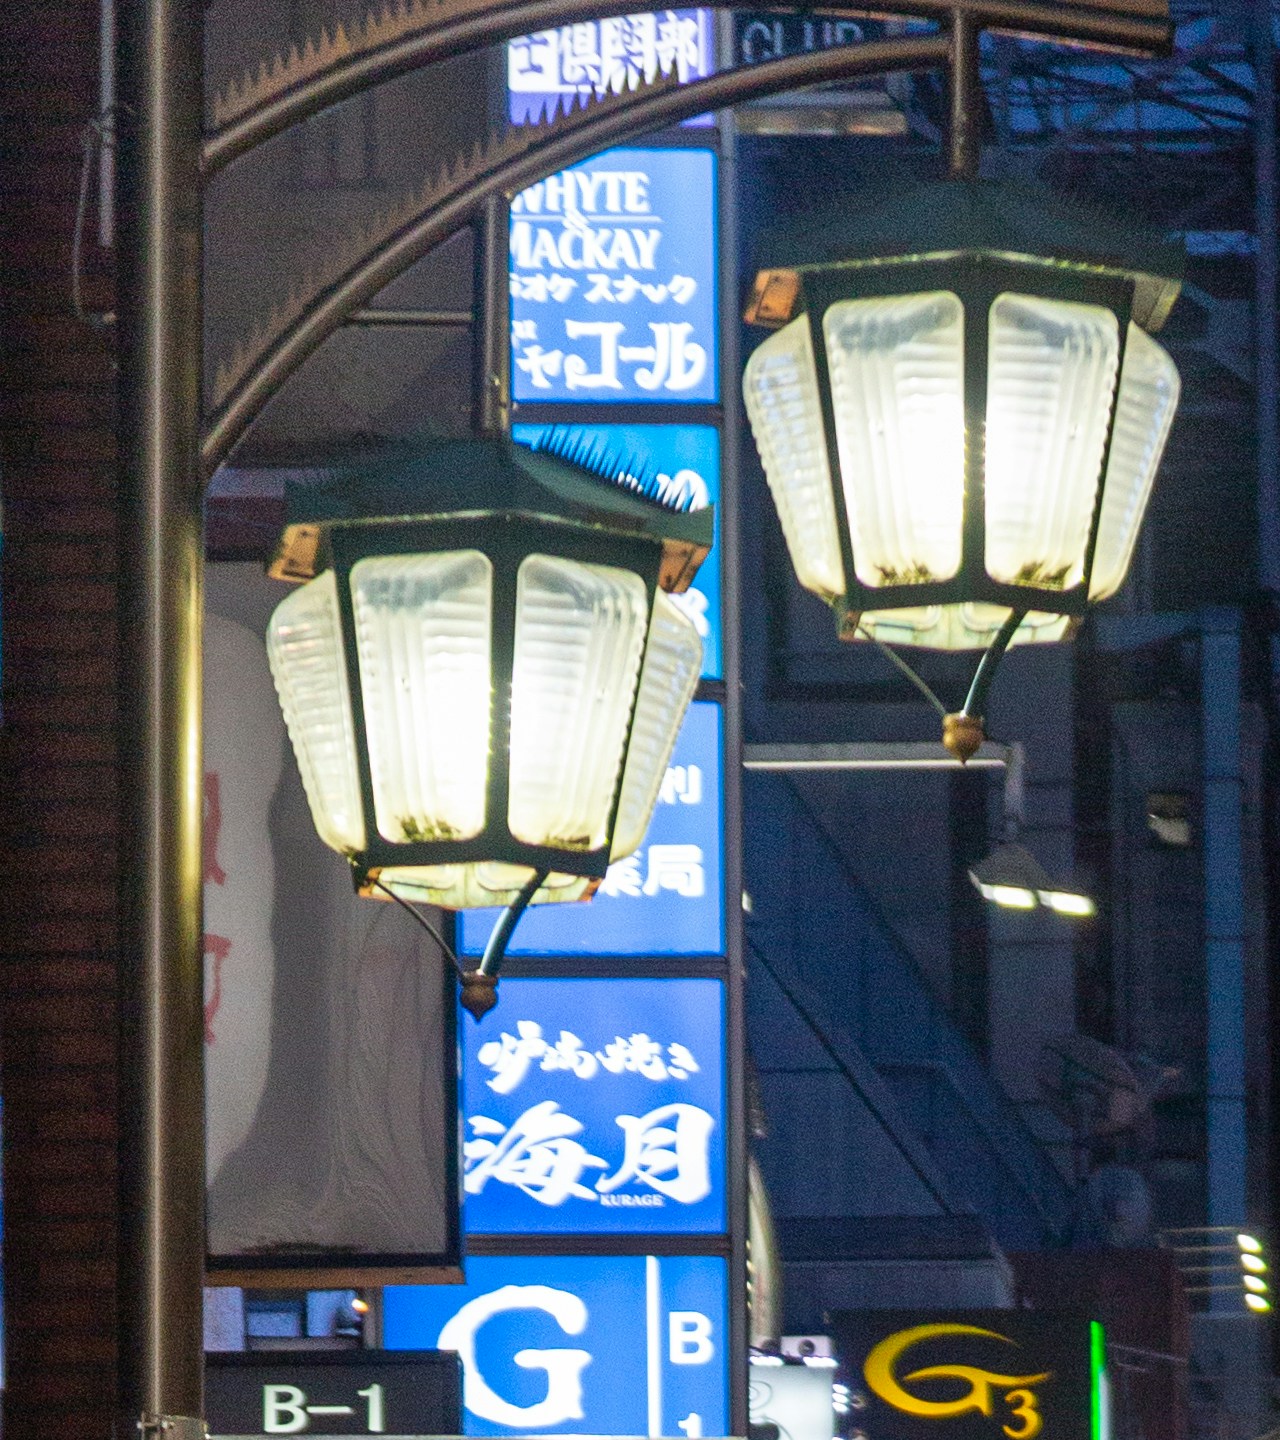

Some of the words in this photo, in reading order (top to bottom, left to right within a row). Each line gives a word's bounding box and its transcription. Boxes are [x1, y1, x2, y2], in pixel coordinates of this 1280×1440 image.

[513, 171, 649, 213] WHYTE
[584, 274, 697, 303] スナック
[464, 1100, 715, 1206] 海月
[600, 1193, 665, 1206] KURAGE
[437, 1285, 592, 1427] G
[262, 1384, 386, 1433] B-1
